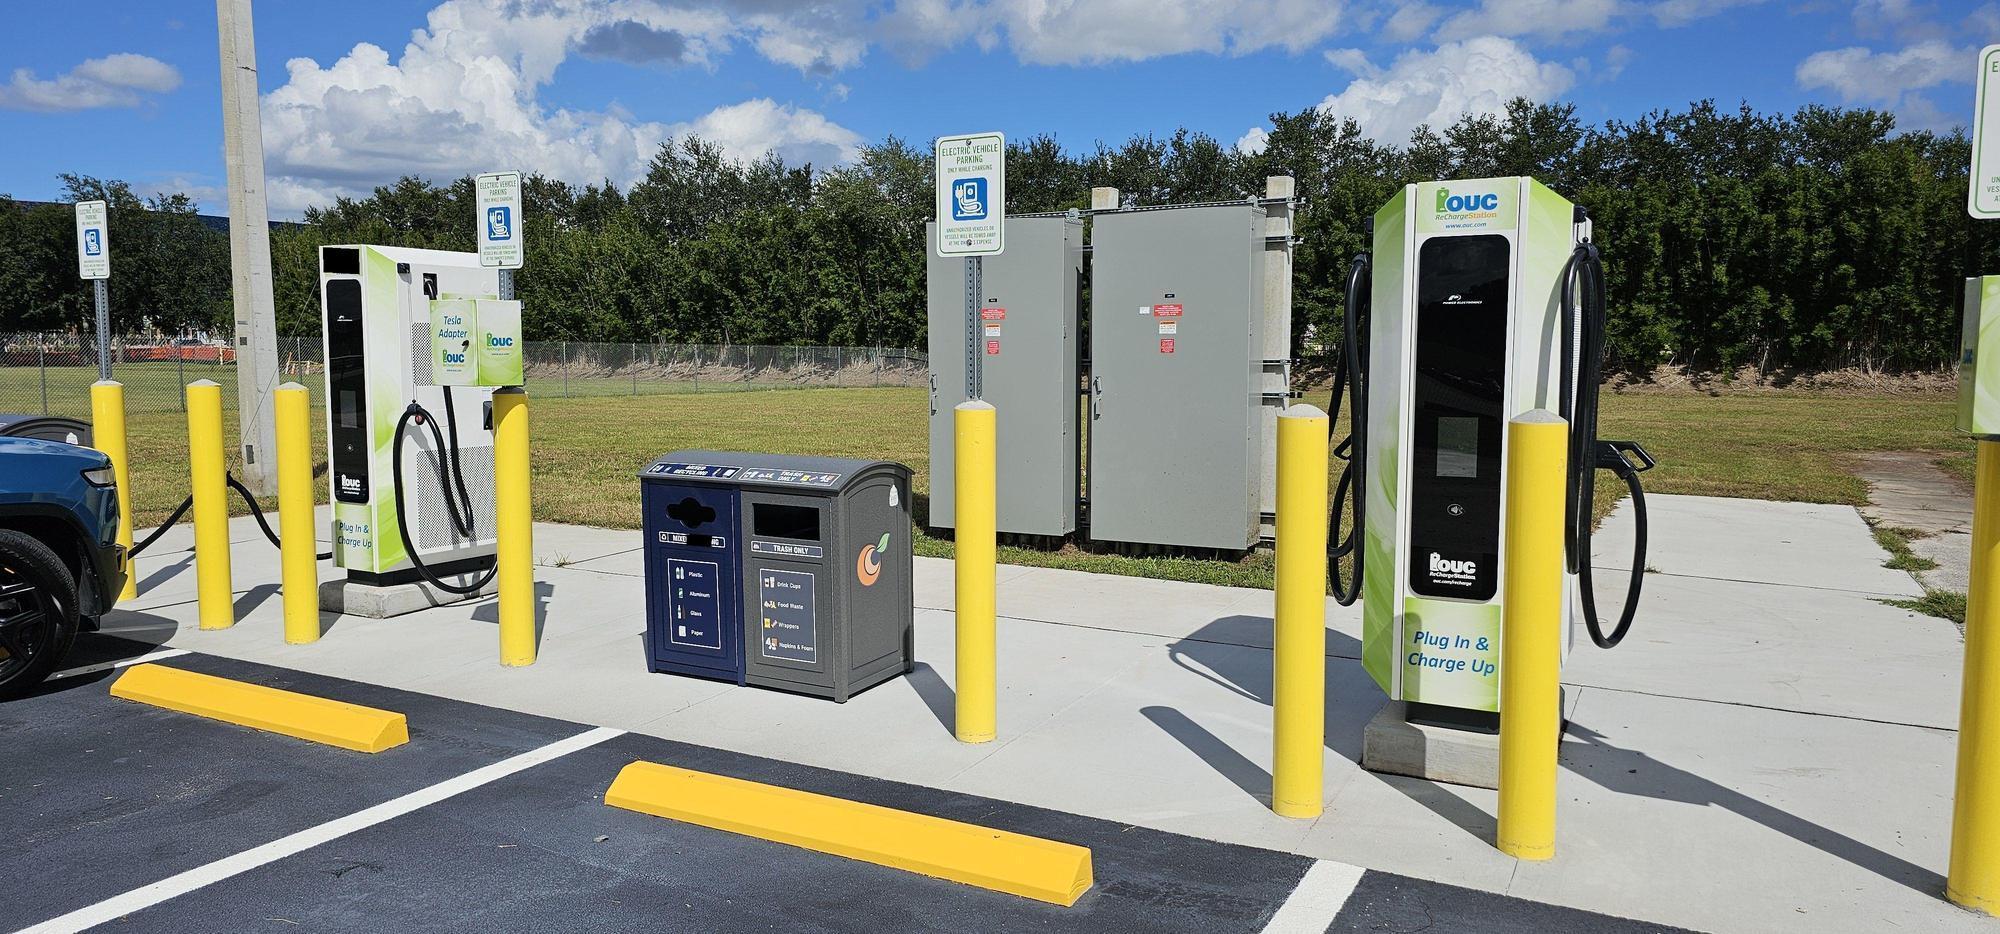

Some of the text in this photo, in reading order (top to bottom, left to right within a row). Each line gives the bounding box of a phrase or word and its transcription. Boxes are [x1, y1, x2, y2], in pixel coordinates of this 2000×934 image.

[942, 143, 998, 157] ELECTRIC VEHICLE
[957, 155, 982, 164] PARKING
[1446, 194, 1498, 212] ouc
[1435, 212, 1497, 221] ReChargeStation
[443, 315, 462, 325] Tesla
[438, 329, 467, 340] Adapter
[491, 337, 513, 347] ouc
[446, 354, 465, 363] ouc
[339, 522, 369, 534] Plug In &
[337, 535, 372, 549] Charge Up
[773, 544, 809, 554] TRASH ONLY
[1438, 559, 1476, 574] ouc
[1429, 571, 1476, 580] ReChargeStation
[689, 591, 711, 599] Aluminum
[777, 601, 790, 609] Food
[778, 621, 800, 630] Wrappers
[690, 629, 704, 637] Paper
[1414, 631, 1489, 651] Plug In &
[778, 642, 797, 650] Napkins
[801, 644, 814, 652] Foam
[1408, 652, 1496, 677] Charge Up
